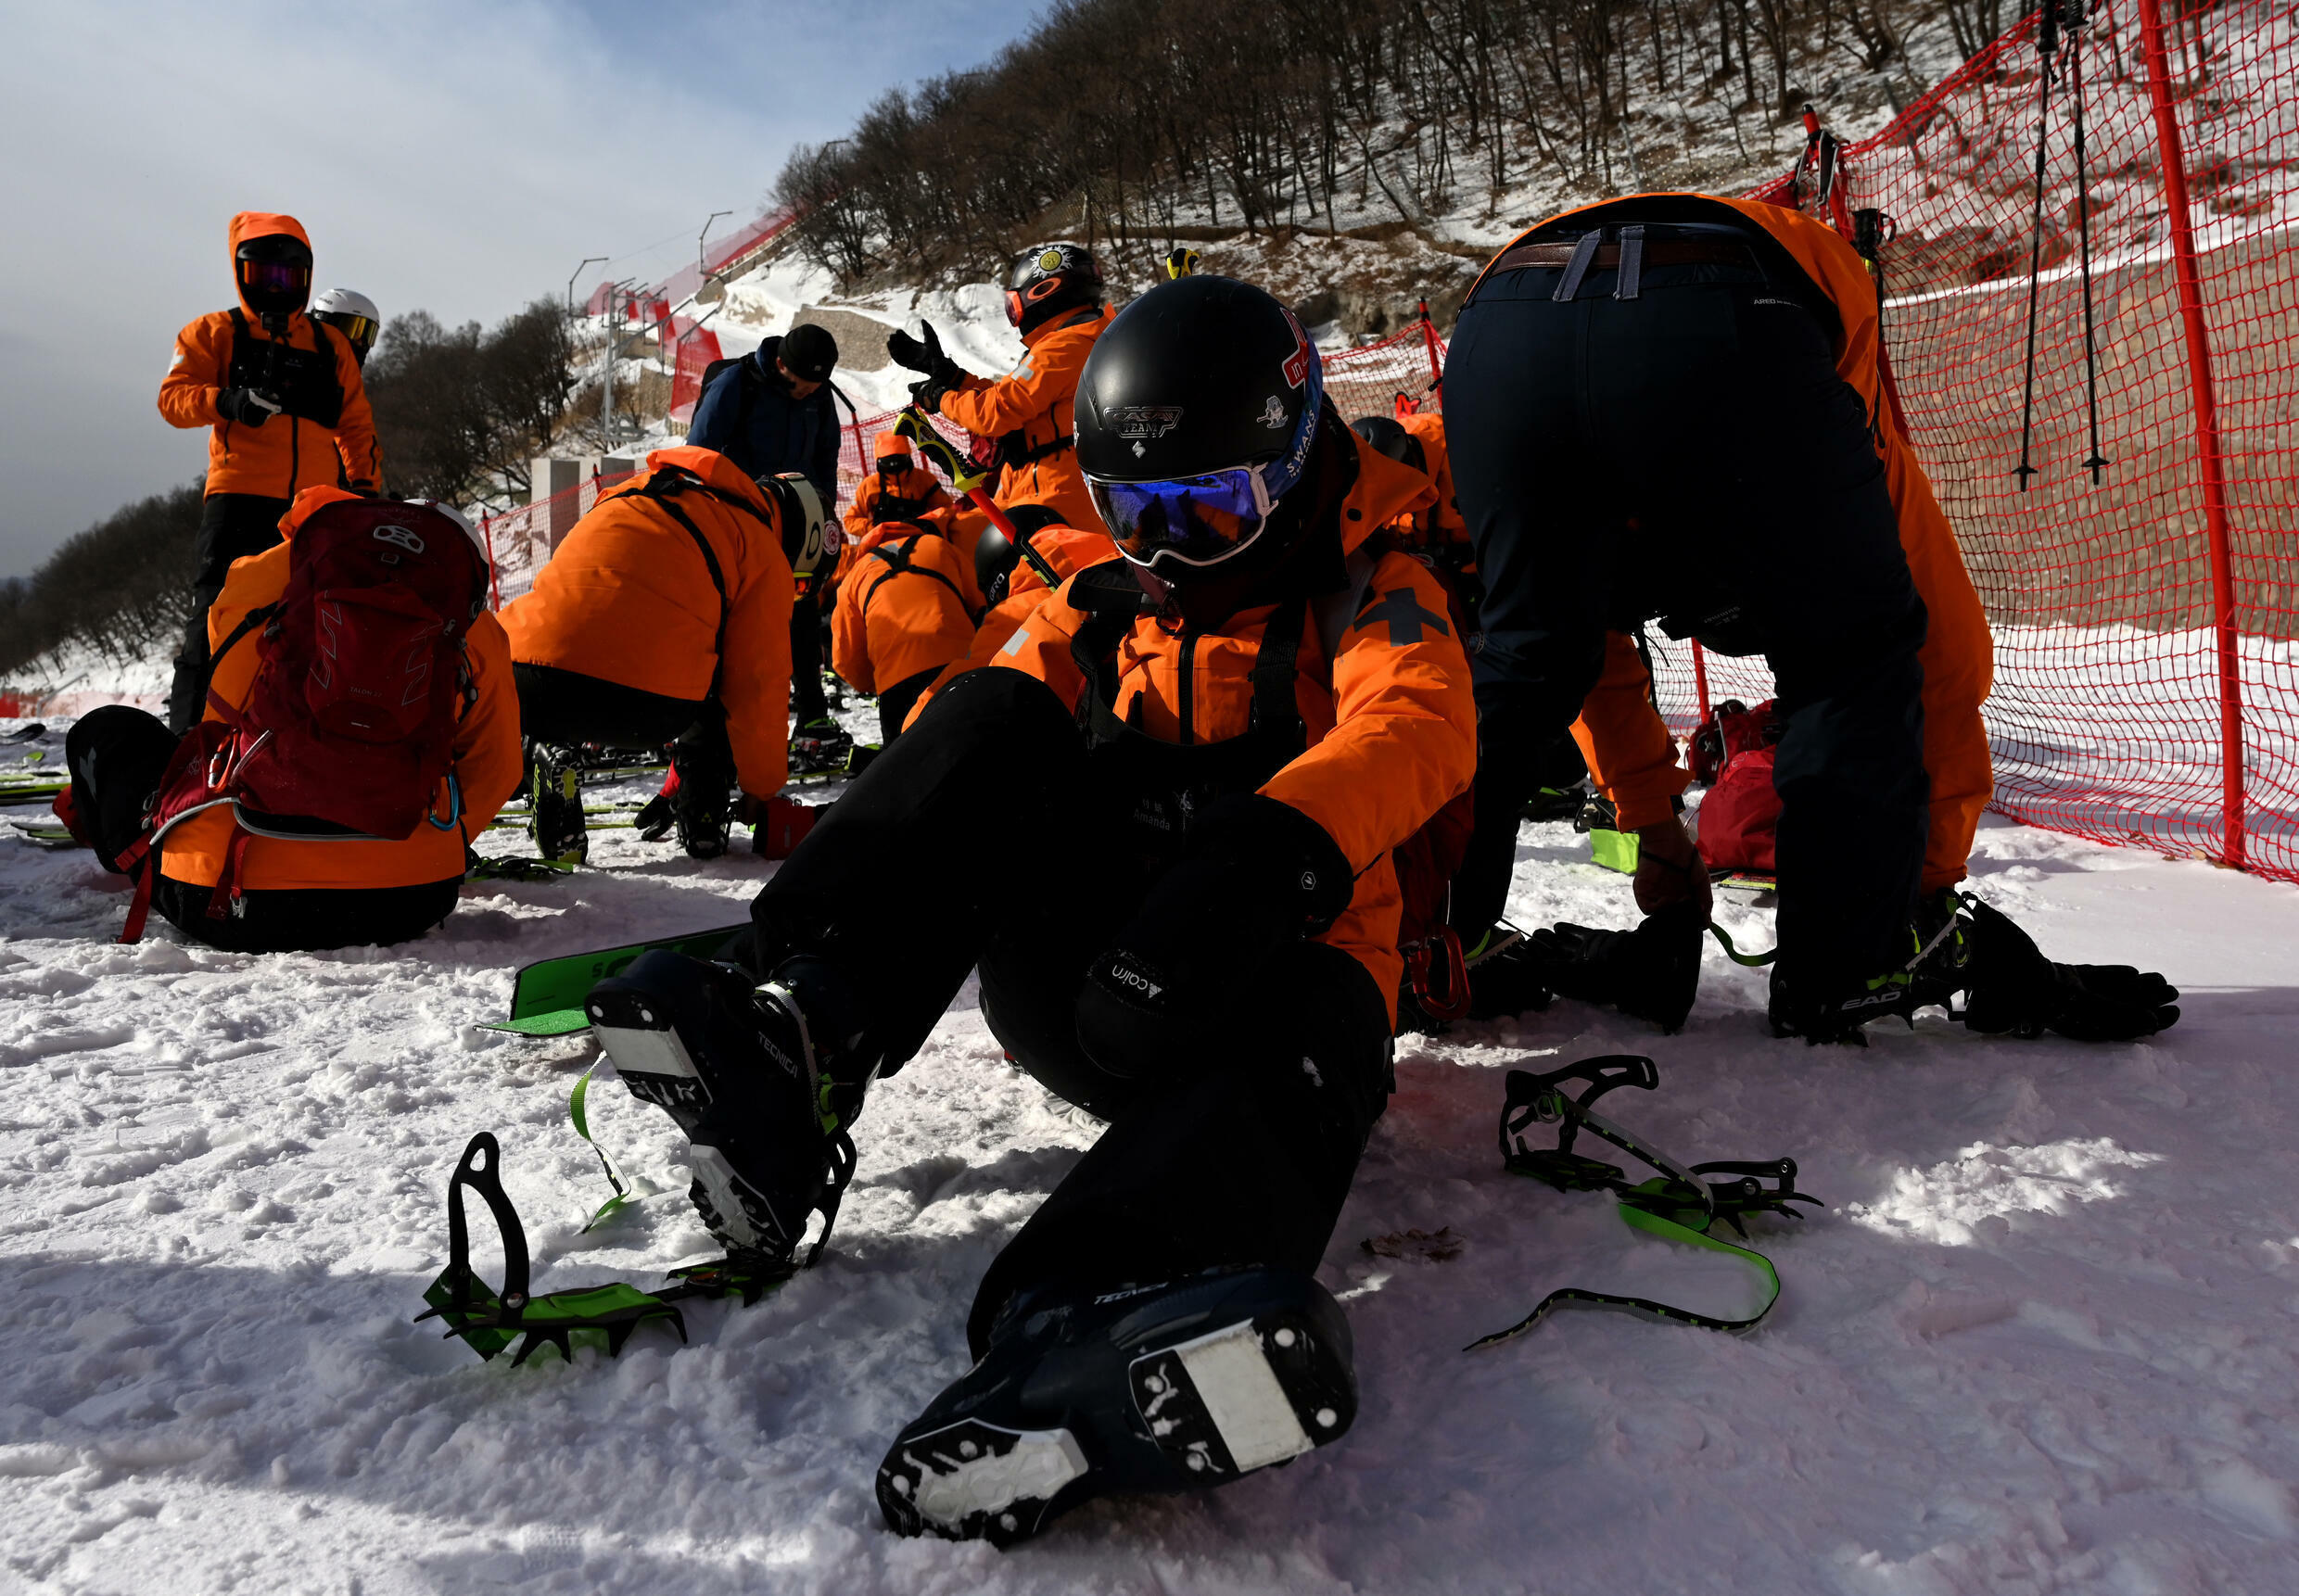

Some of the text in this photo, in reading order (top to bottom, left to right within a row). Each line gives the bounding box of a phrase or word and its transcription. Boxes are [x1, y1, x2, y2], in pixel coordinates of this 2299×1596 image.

[1287, 409, 1317, 475] SWANS
[1133, 807, 1171, 830] Amanda
[1111, 965, 1149, 991] cairn
[757, 1030, 800, 1079] TECNICA
